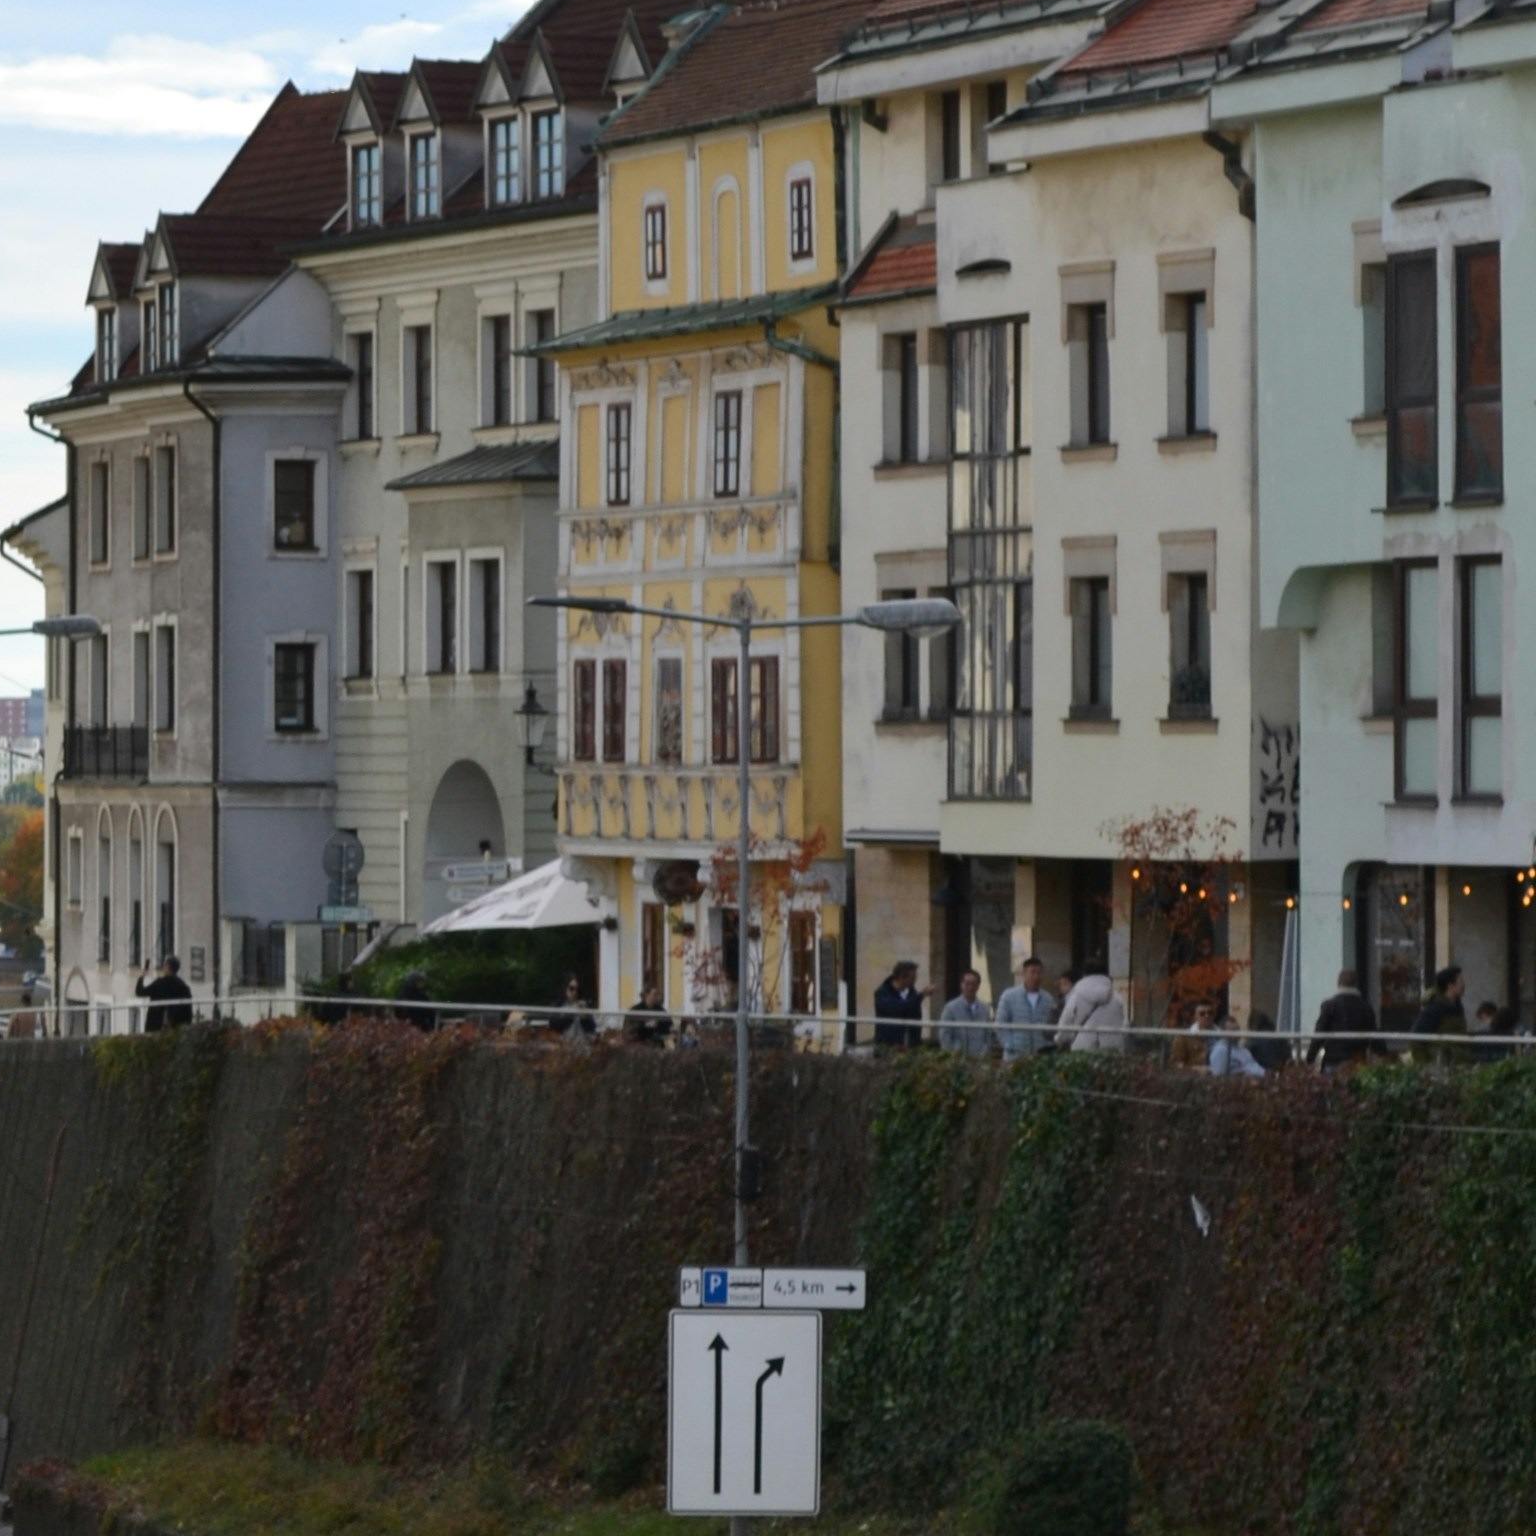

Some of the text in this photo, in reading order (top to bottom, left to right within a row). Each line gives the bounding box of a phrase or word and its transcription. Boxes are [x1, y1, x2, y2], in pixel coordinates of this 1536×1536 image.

[682, 1278, 700, 1295] P1
[709, 1273, 722, 1295] P
[773, 1279, 824, 1296] 4,5 km
